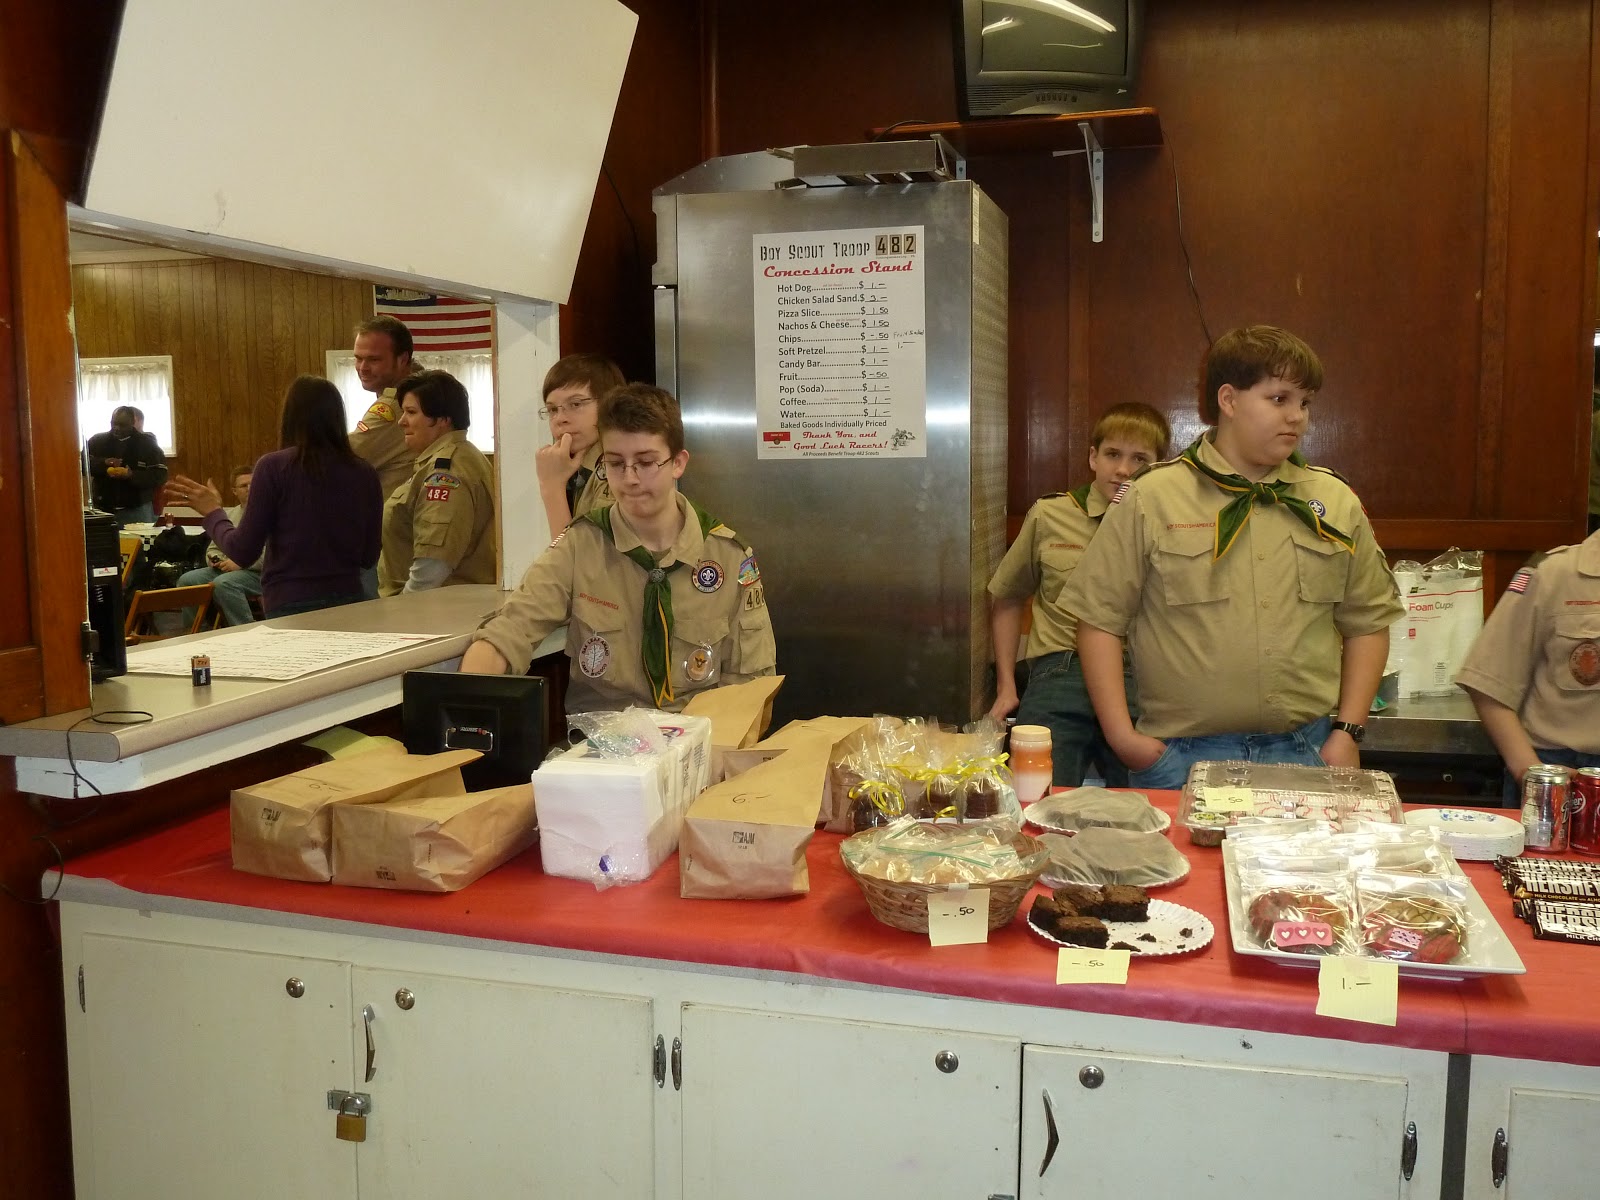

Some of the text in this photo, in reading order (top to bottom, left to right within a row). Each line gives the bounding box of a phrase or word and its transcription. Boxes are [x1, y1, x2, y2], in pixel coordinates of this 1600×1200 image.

[877, 235, 915, 254] 482
[764, 260, 913, 278] Concession Stand
[777, 284, 792, 293] Hot
[777, 296, 810, 305] Chicken
[812, 295, 835, 304] Salad
[778, 309, 799, 318] Pizza
[778, 321, 809, 331] Nachos
[810, 321, 817, 329] &
[778, 347, 796, 356] Soft
[797, 346, 826, 355] Pretzel
[778, 360, 805, 370] Candy
[779, 385, 795, 395] Pop
[780, 421, 801, 429] Baked
[824, 420, 864, 429] Individually
[802, 431, 832, 439] Thank
[793, 442, 817, 451] Good
[819, 441, 846, 450] Luck
[849, 440, 888, 449] Racers!
[427, 489, 448, 500] 482
[1409, 601, 1454, 612] Foam Cups
[1566, 933, 1586, 941] MILK
